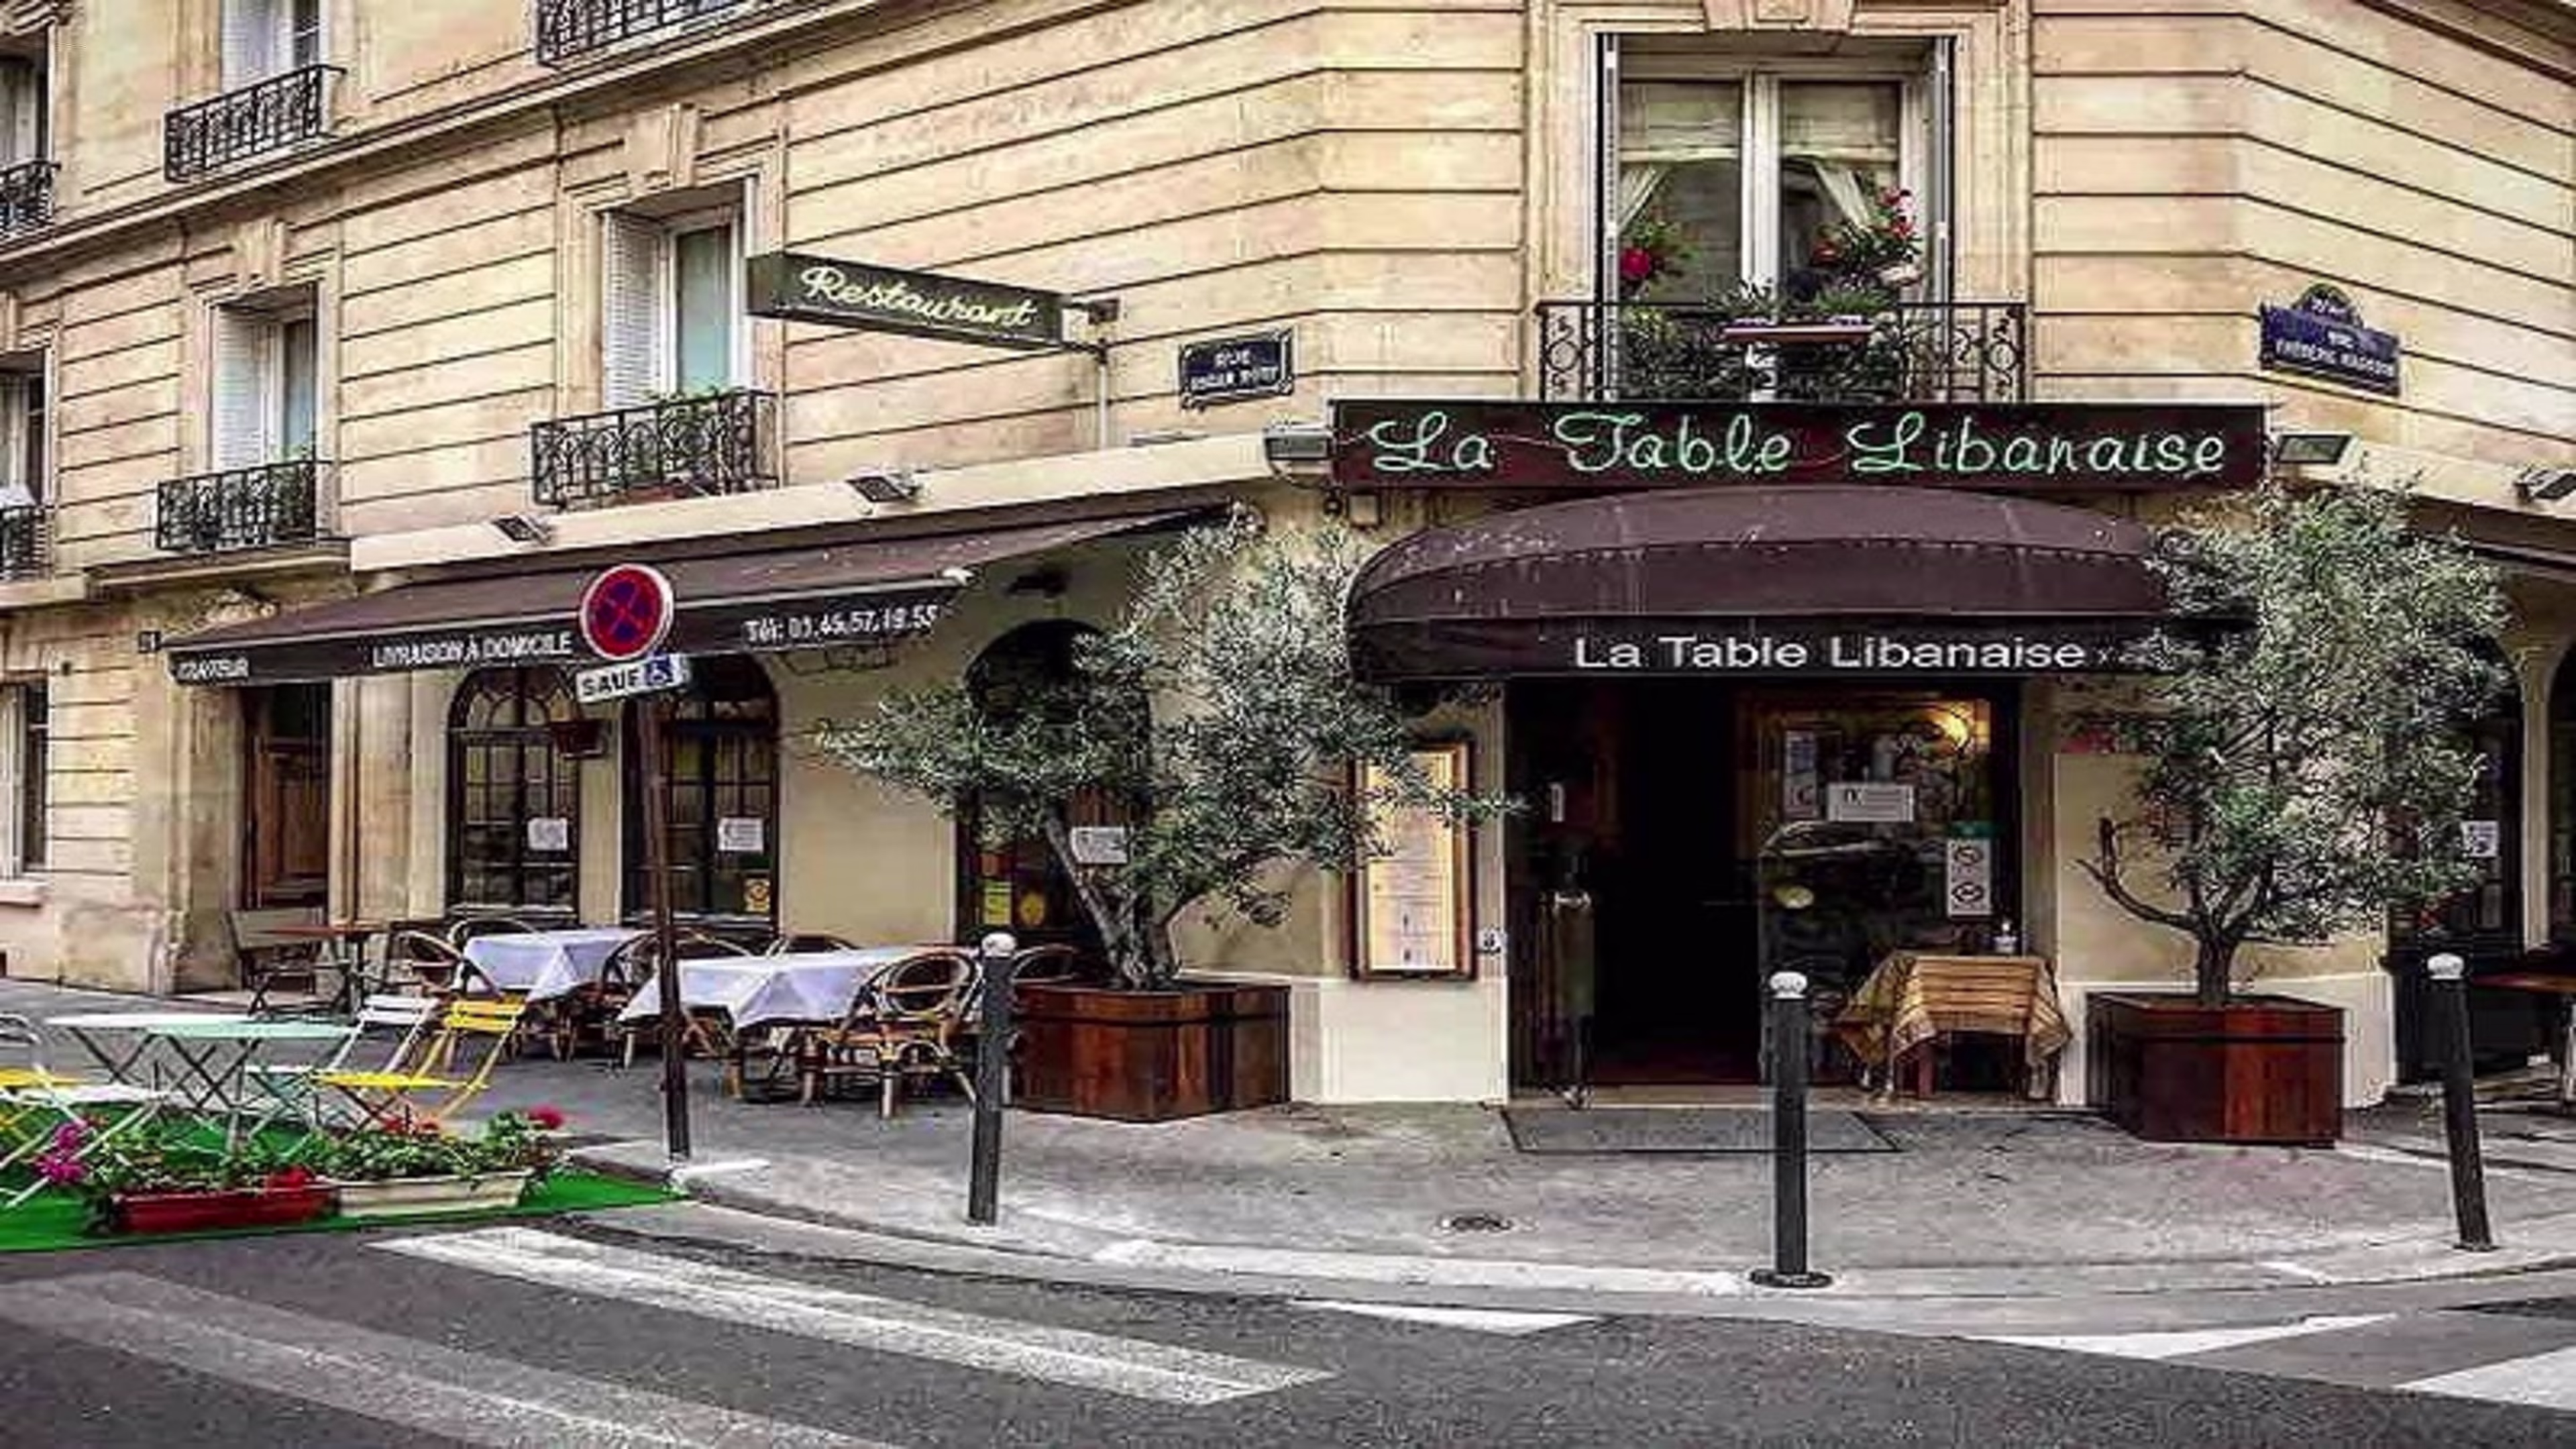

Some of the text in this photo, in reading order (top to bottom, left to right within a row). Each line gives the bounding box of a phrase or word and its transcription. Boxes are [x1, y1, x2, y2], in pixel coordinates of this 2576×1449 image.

[801, 267, 1037, 327] Restaurant
[1368, 411, 2224, 478] La Table Libanaise
[1576, 637, 2085, 667] La Table Libanaise
[582, 669, 639, 696] SAUF
